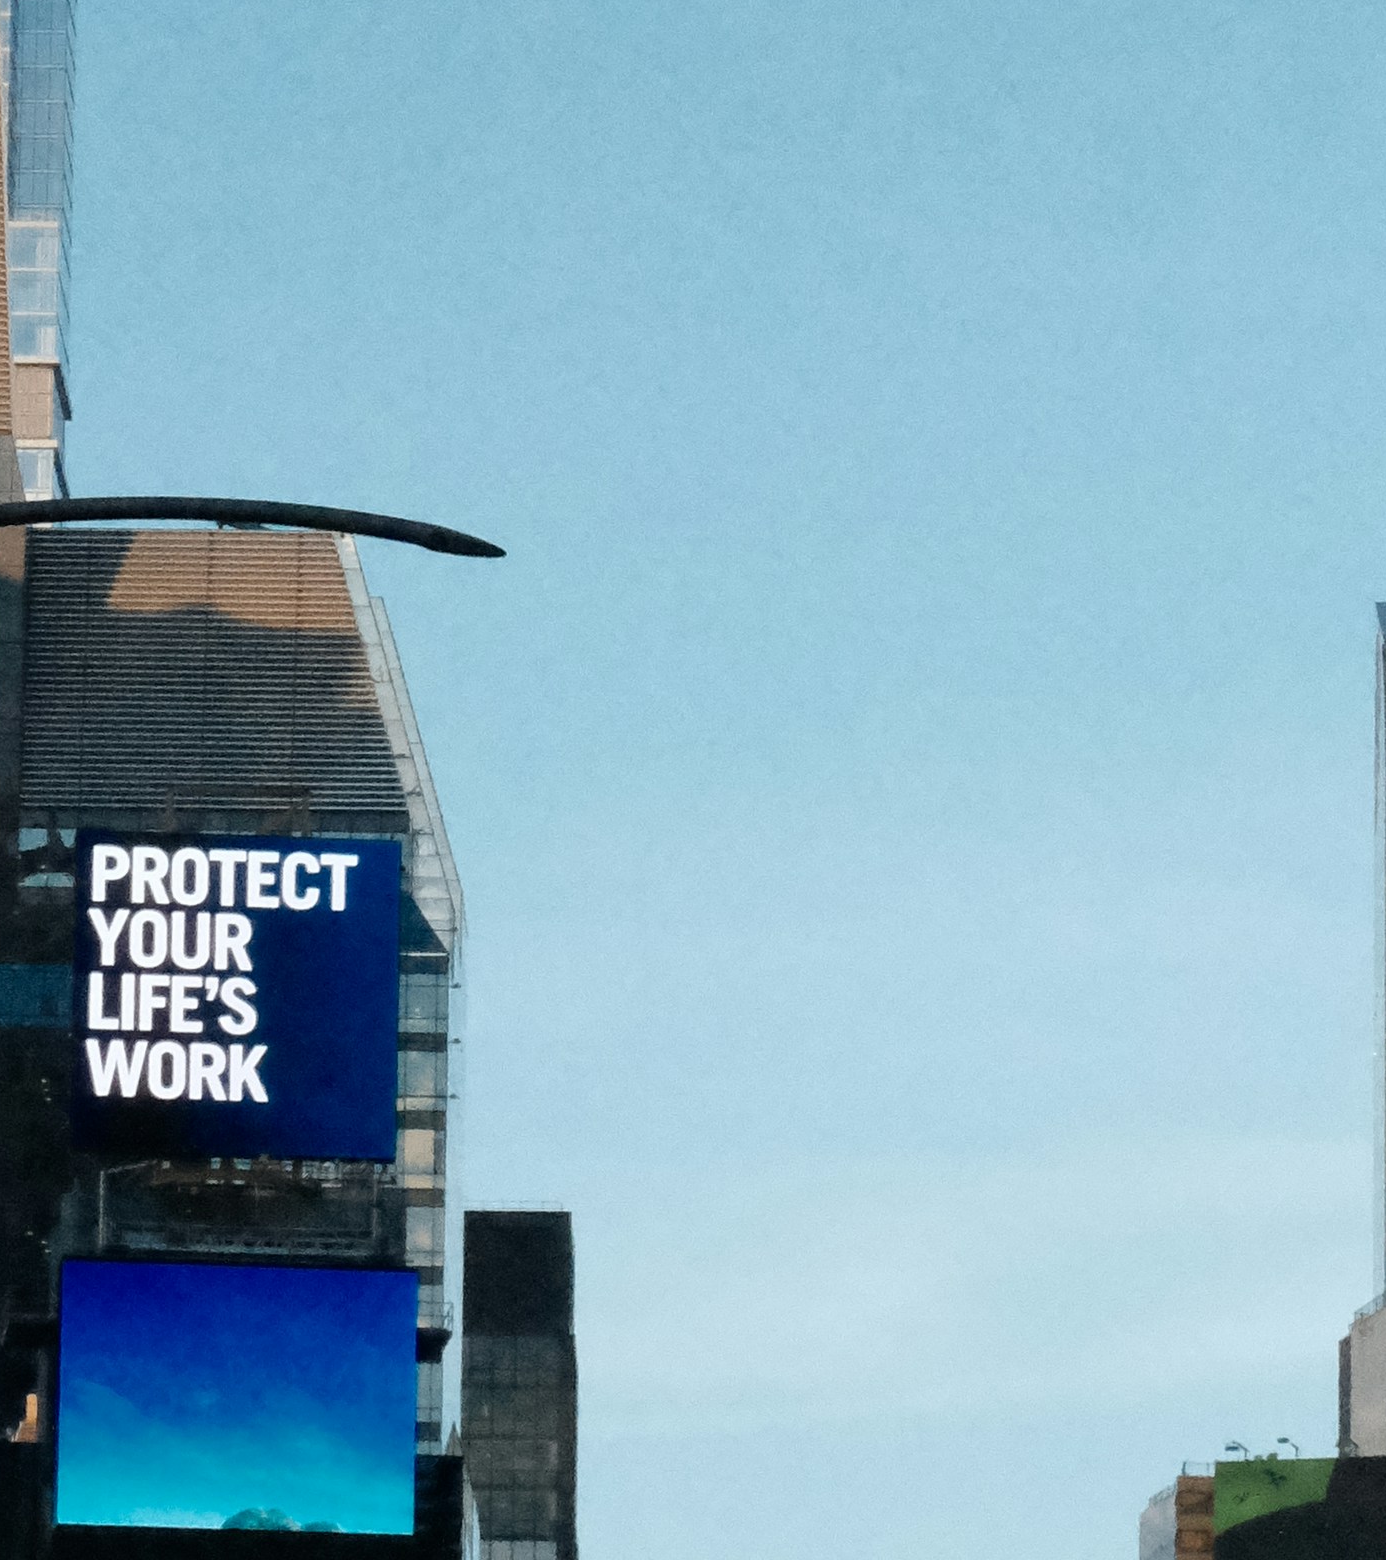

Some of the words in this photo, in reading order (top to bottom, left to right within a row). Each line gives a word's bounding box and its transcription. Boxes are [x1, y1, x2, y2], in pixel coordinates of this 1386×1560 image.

[91, 844, 359, 912] PROTECT
[86, 907, 254, 971] YOUR
[87, 971, 259, 1036] LIFE'S
[85, 1038, 269, 1103] WORK
